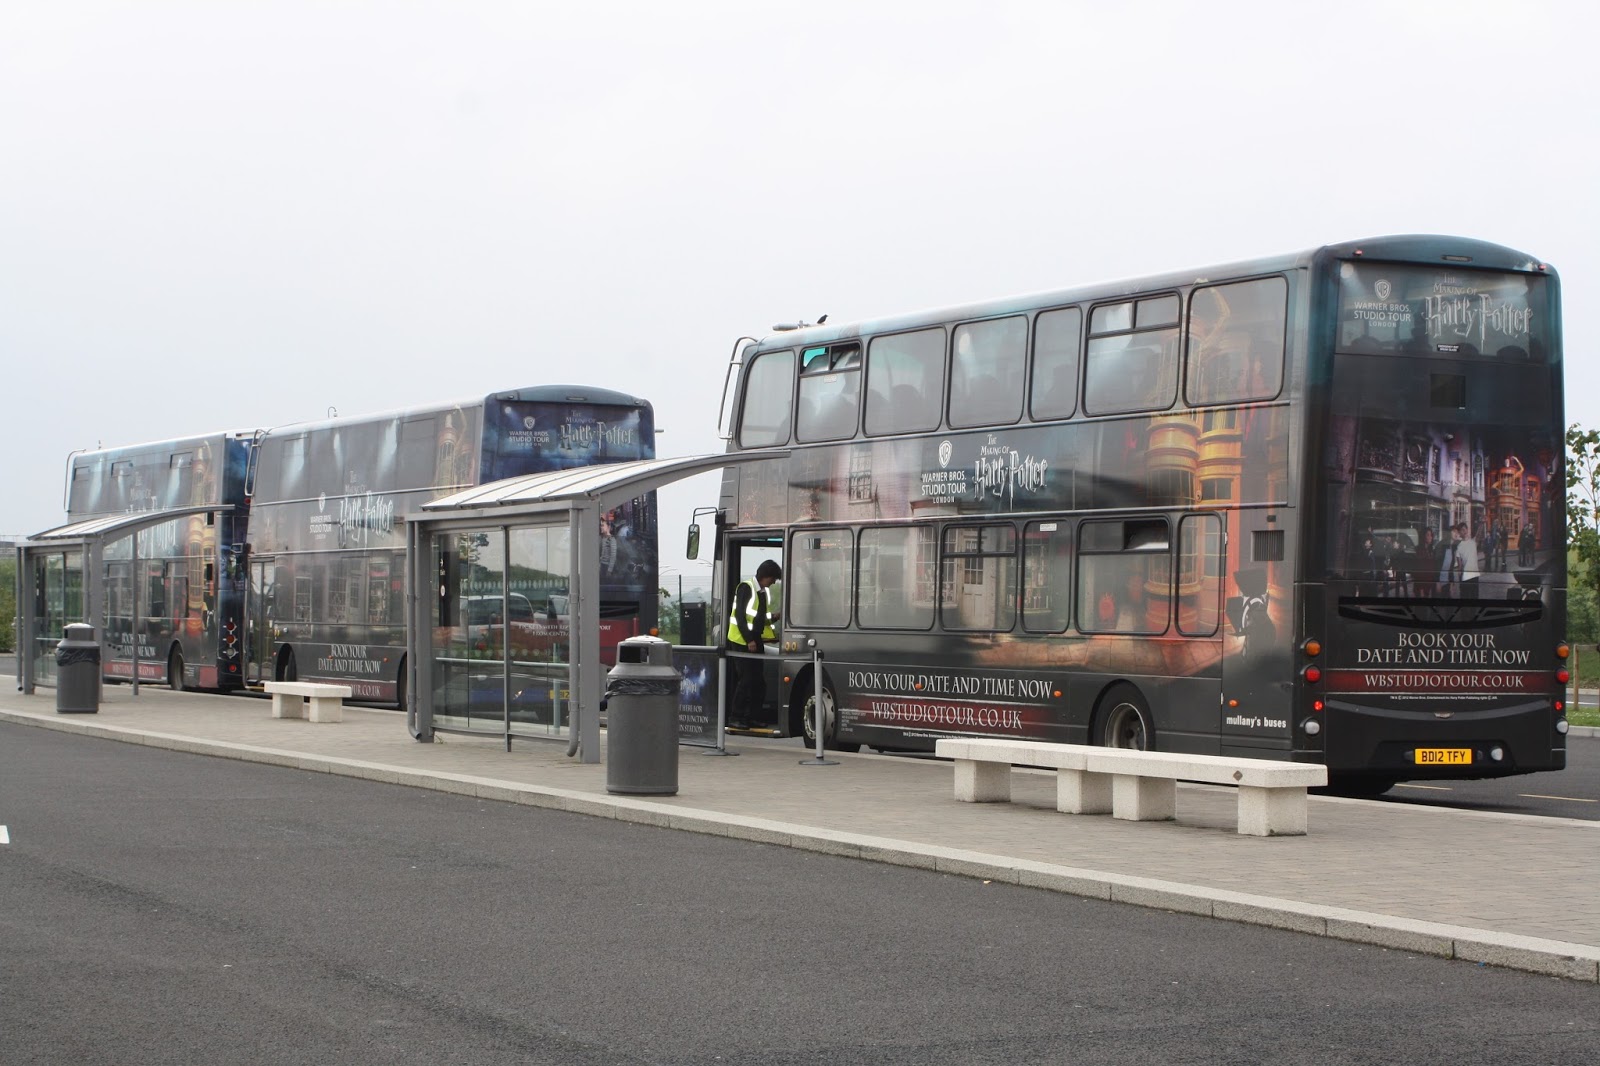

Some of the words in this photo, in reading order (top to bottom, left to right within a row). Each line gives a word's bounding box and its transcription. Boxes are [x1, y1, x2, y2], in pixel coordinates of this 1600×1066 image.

[1354, 301, 1391, 312] WARNER
[1392, 303, 1411, 313] BROS.
[1354, 310, 1386, 321] STUDIO
[1387, 311, 1411, 322] TOUR
[1421, 294, 1477, 339] Harry
[1475, 293, 1533, 352] Potter
[1368, 320, 1397, 328] LONDON
[922, 471, 948, 483] WARNER
[948, 470, 967, 481] BROS.
[972, 455, 1008, 502] Harry
[1007, 451, 1048, 511] Potter
[921, 483, 947, 496] STUDIO
[947, 482, 967, 494] TOUR
[932, 495, 955, 504] LONDON
[1399, 632, 1448, 648] BOOK
[1449, 633, 1496, 649] YOUR
[331, 644, 348, 657] BOOK
[348, 644, 367, 659] YOUR
[1357, 648, 1403, 664] DATE
[1406, 650, 1444, 664] AND
[1447, 650, 1488, 664] TIME
[1492, 651, 1530, 665] NOW
[318, 658, 333, 671] DATE
[333, 659, 348, 672] AND
[348, 659, 364, 673] TIME
[364, 660, 382, 674] NOW
[848, 671, 882, 690] BOOK
[883, 673, 916, 691] YOUR
[918, 674, 950, 693] DATE
[952, 676, 980, 695] AND
[982, 677, 1015, 697] TIME
[1018, 679, 1053, 699] NOW
[1364, 674, 1524, 688] WBSTUDIOTOUR.CO.UK
[872, 702, 1022, 730] WBSTUDIOTOUR.CO.UK
[1226, 715, 1261, 728] mullany's
[1263, 717, 1287, 728] buses
[1421, 750, 1444, 763] BD12
[1446, 750, 1466, 763] TFY
